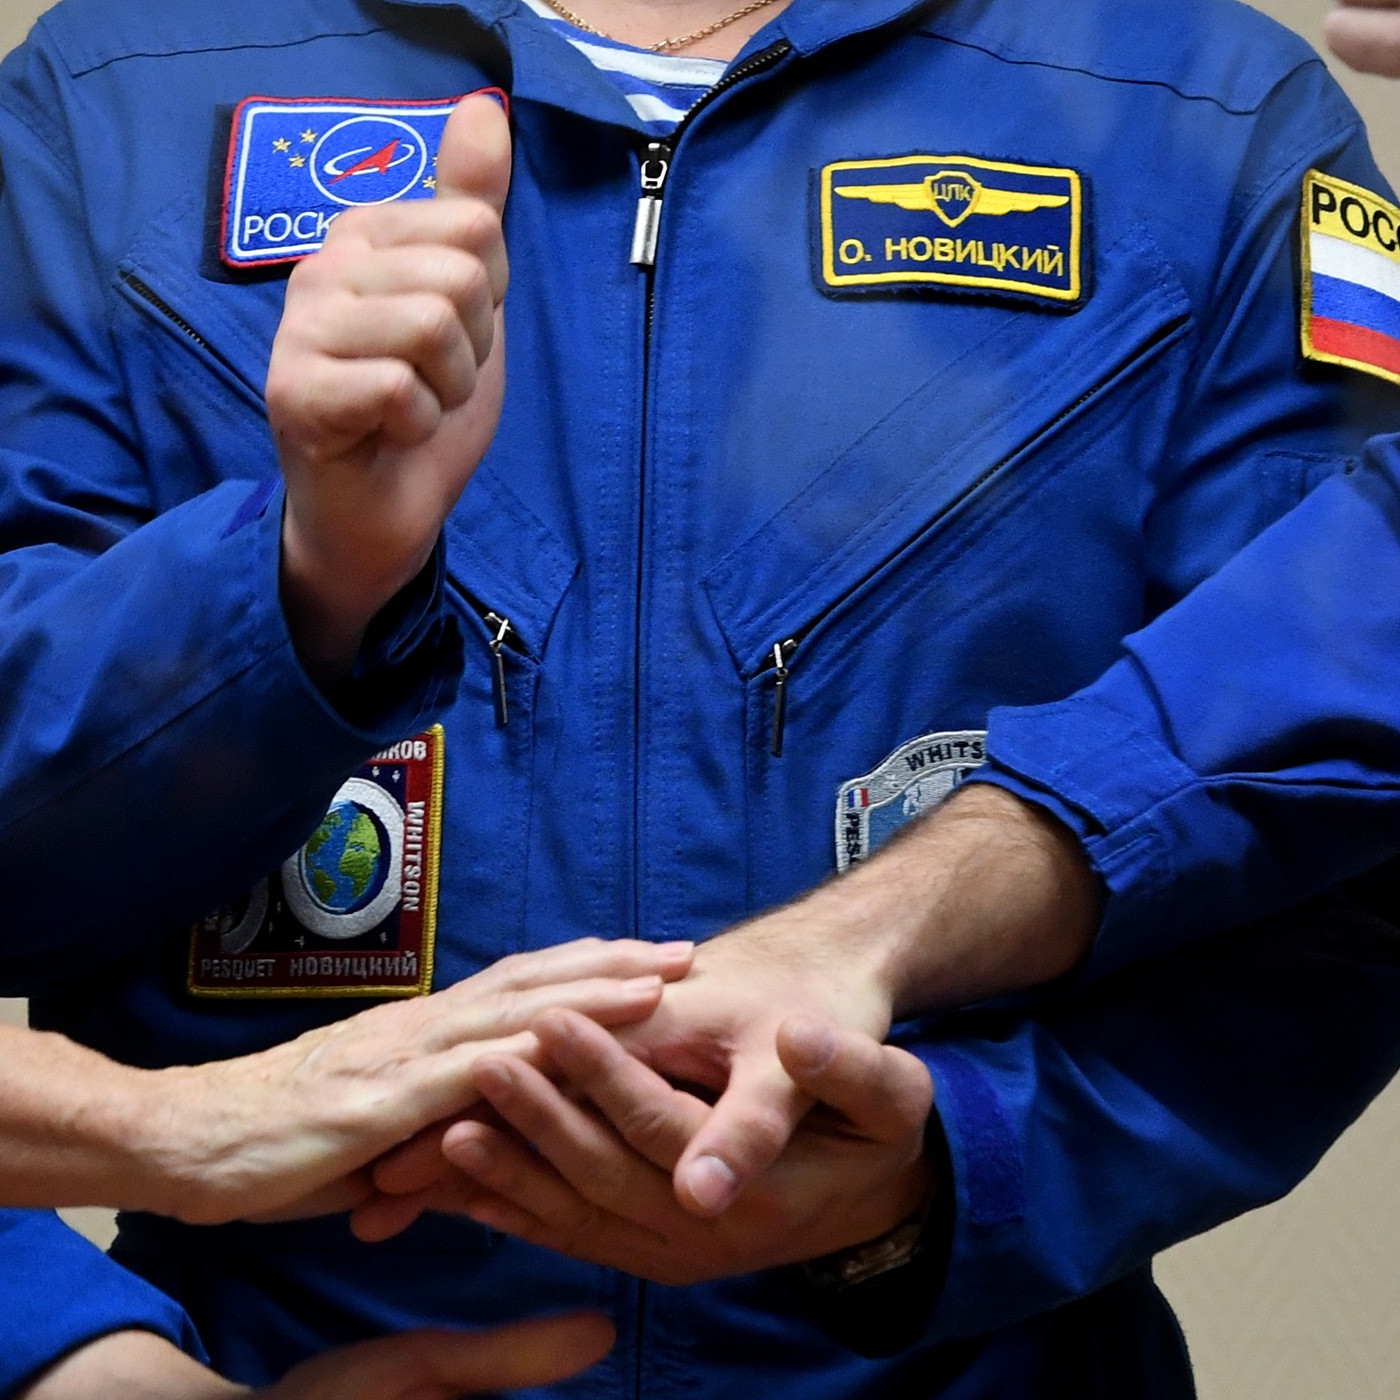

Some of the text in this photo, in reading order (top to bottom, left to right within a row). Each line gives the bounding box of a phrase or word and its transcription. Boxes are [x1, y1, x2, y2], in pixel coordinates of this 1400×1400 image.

[933, 183, 972, 202] ЦПК
[243, 211, 341, 244] РОСК
[839, 236, 1064, 277] О. НОВИЦКИЙ
[905, 740, 984, 771] WHITS
[846, 812, 861, 863] PES
[403, 800, 425, 912] WHITSON
[200, 950, 418, 981] PESQUET НОВИЦКИЙ
